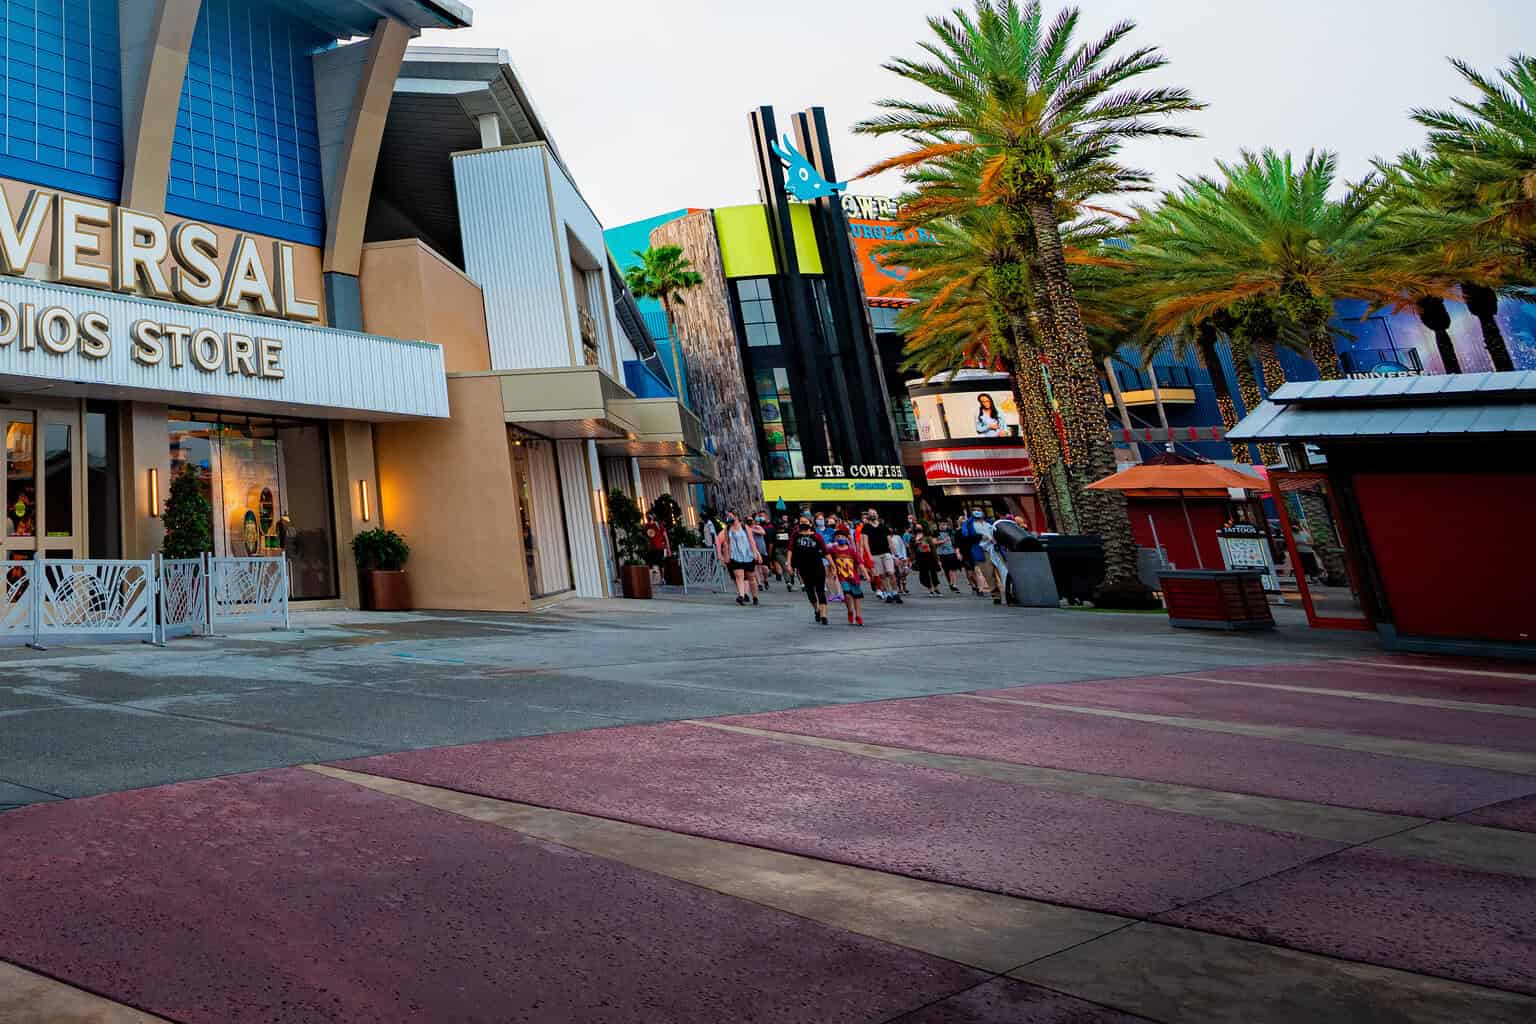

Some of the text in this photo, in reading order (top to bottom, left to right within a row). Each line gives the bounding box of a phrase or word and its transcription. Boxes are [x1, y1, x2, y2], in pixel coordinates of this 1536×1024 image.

[131, 319, 286, 380] STORE
[813, 465, 903, 478] THE COWFISH
